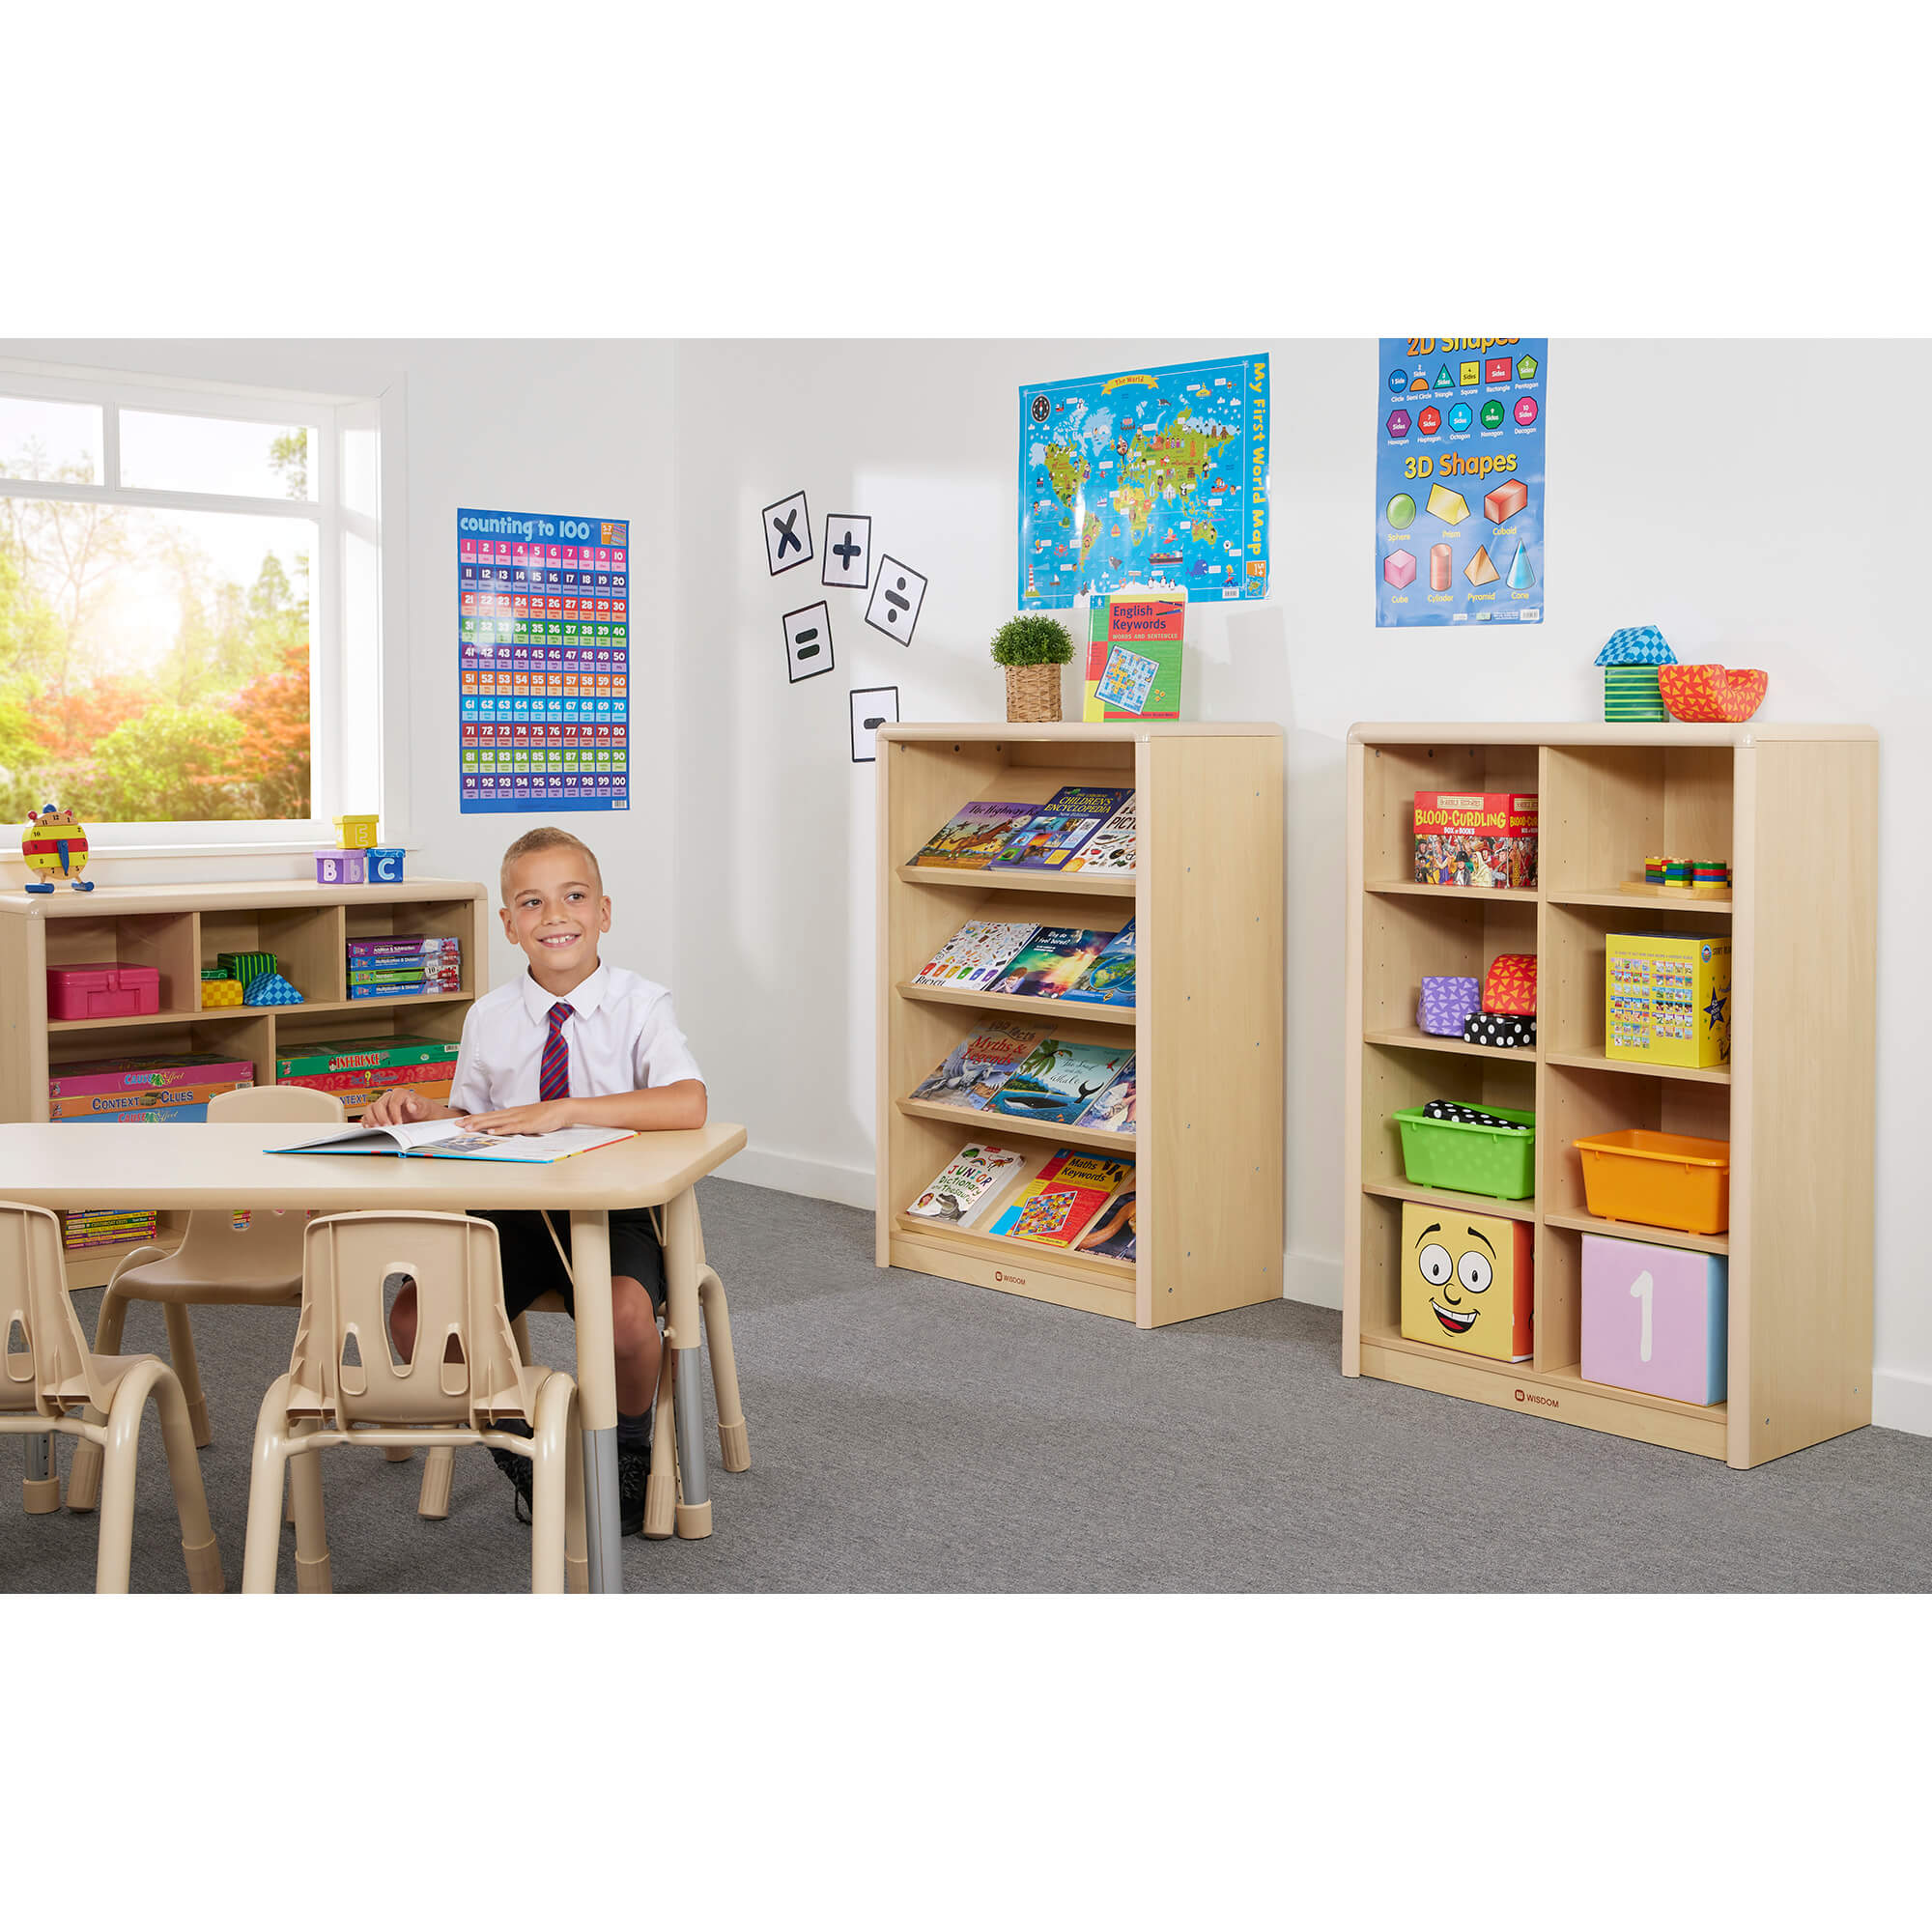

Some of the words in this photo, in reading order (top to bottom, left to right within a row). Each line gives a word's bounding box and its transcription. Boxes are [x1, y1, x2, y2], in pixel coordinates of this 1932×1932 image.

[1407, 338, 1435, 357] 2D
[1114, 378, 1126, 386] The
[1249, 362, 1265, 393] My
[1514, 382, 1539, 390] Pentagon
[1434, 391, 1454, 399] Triangle
[1461, 388, 1478, 397] Square
[1252, 399, 1266, 441] First
[1514, 427, 1537, 435] Decagon
[1404, 456, 1434, 480] 3D
[1439, 451, 1518, 481] Shapes
[1252, 446, 1266, 503] World
[460, 516, 533, 541] counting
[538, 520, 554, 536] to
[559, 521, 590, 540] 100
[1248, 510, 1266, 556] Map
[1492, 526, 1517, 536] Cuboid
[468, 542, 469, 551] 1
[483, 543, 489, 552] 2
[518, 546, 524, 554] 4
[533, 547, 540, 555] 5
[583, 550, 589, 558] 8
[614, 552, 623, 560] 10
[482, 570, 492, 580] 12
[499, 571, 507, 581] 13
[533, 572, 541, 581] 15
[1391, 594, 1408, 603] Cube
[1427, 593, 1454, 604] Cylinder
[1467, 592, 1496, 604] Pyramid
[1511, 591, 1529, 600] Cone
[1114, 605, 1153, 619] English
[1113, 618, 1166, 632] Keywords
[582, 651, 592, 660] 48
[613, 652, 625, 661] 50
[517, 778, 527, 786] 94
[1059, 796, 1113, 806] CHILDREN'S
[969, 805, 985, 814] The
[985, 805, 1023, 817] Highway
[1044, 803, 1112, 813] ENCYCLOPEDIA
[1415, 809, 1506, 829] BLOOD-CURDLING
[355, 824, 369, 846] E
[323, 859, 337, 881] B
[350, 859, 361, 881] b
[378, 858, 395, 880] C
[1114, 932, 1136, 946] A
[1010, 1025, 1036, 1041] facts
[970, 1036, 1012, 1052] Myths
[1012, 1043, 1026, 1054] &
[336, 1052, 380, 1069] INFERENCE
[961, 1048, 1014, 1065] Legends
[124, 1074, 152, 1085] CAUSE
[1050, 1074, 1080, 1084] Whale
[92, 1096, 139, 1111] CONTEXT
[161, 1090, 193, 1103] CLUES
[118, 1112, 146, 1122] CAUSE
[1068, 1158, 1098, 1170] Maths
[947, 1165, 992, 1186] JUNIOR
[1061, 1167, 1105, 1182] Keywords
[939, 1175, 981, 1196] Dictionary
[942, 1185, 976, 1205] Thesaurus
[1003, 1274, 1026, 1286] WISDOM
[1630, 1270, 1655, 1363] 1
[1526, 1394, 1560, 1409] WISDOM
